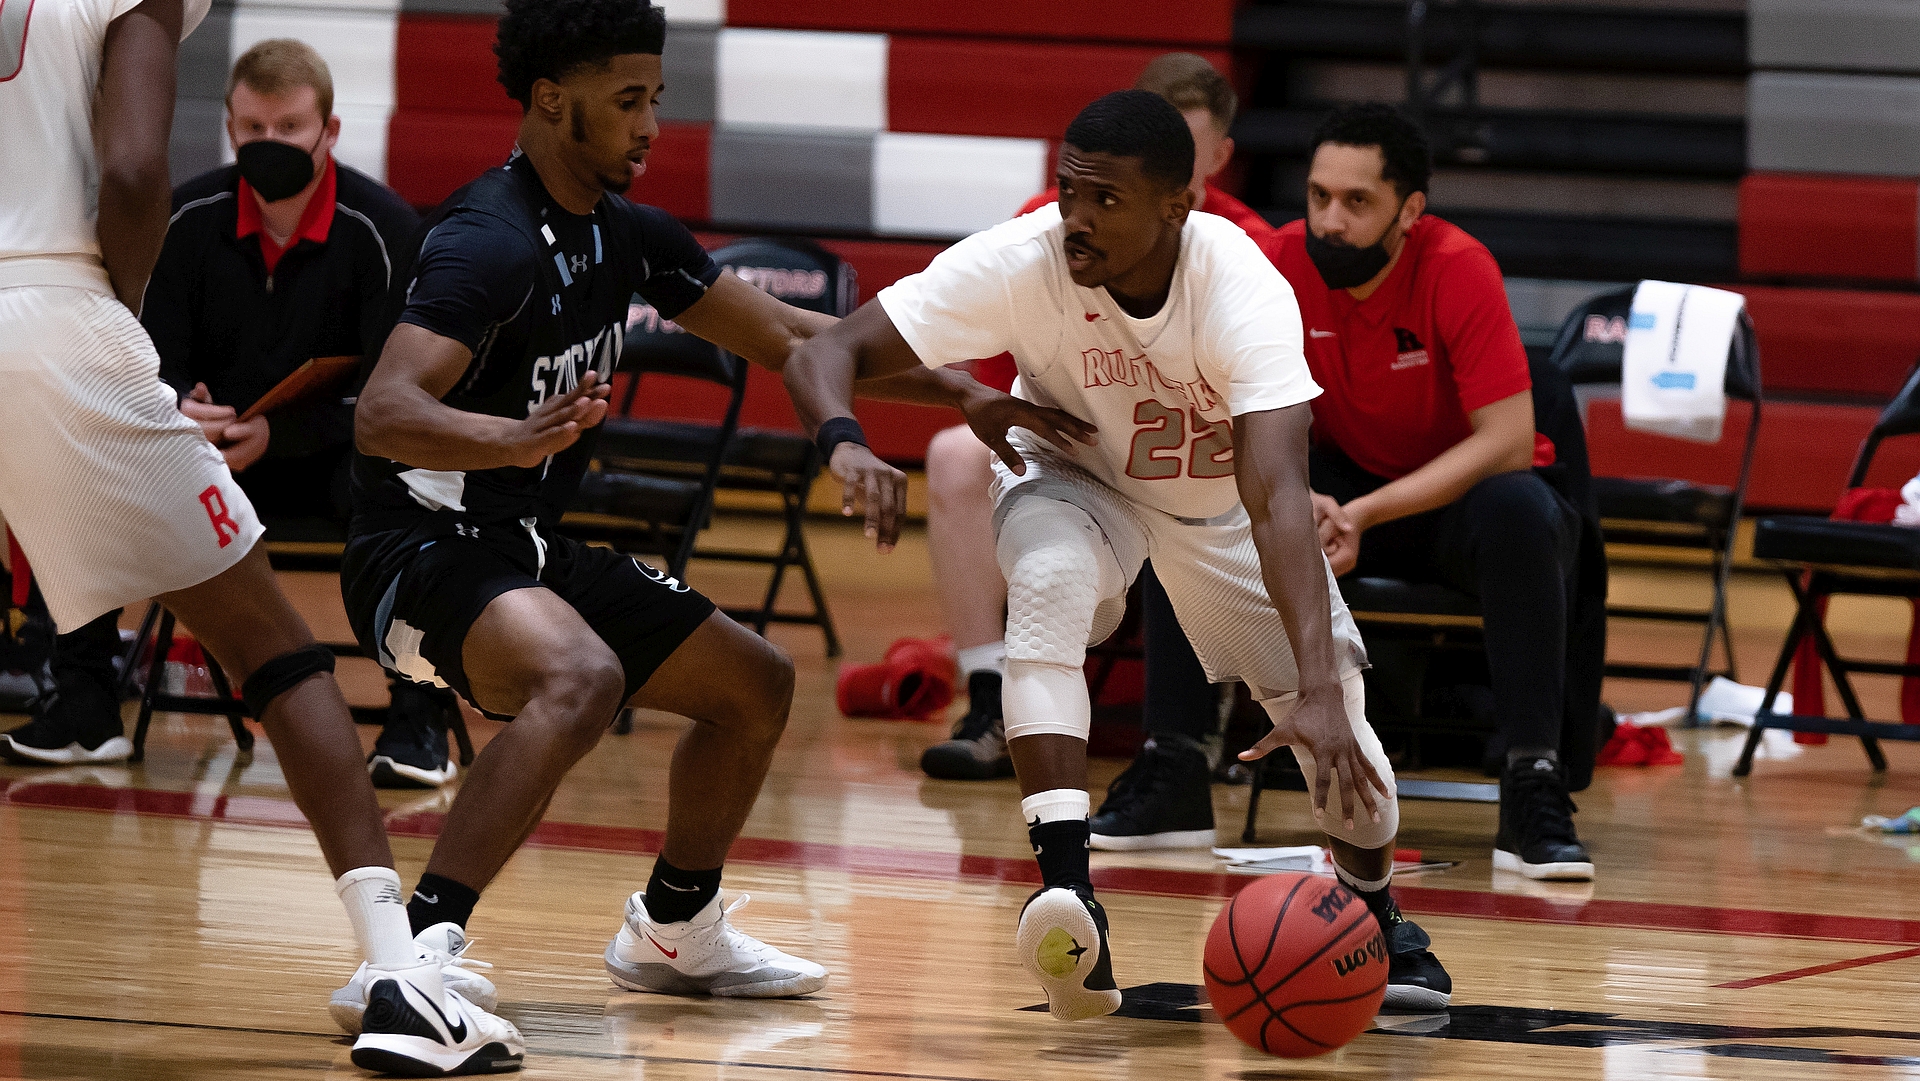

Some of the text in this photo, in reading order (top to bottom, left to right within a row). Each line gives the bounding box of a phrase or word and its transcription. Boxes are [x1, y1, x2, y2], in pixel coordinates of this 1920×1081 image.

[1125, 398, 1235, 480] 22
[198, 484, 240, 549] R
[1311, 884, 1353, 924] CAA
